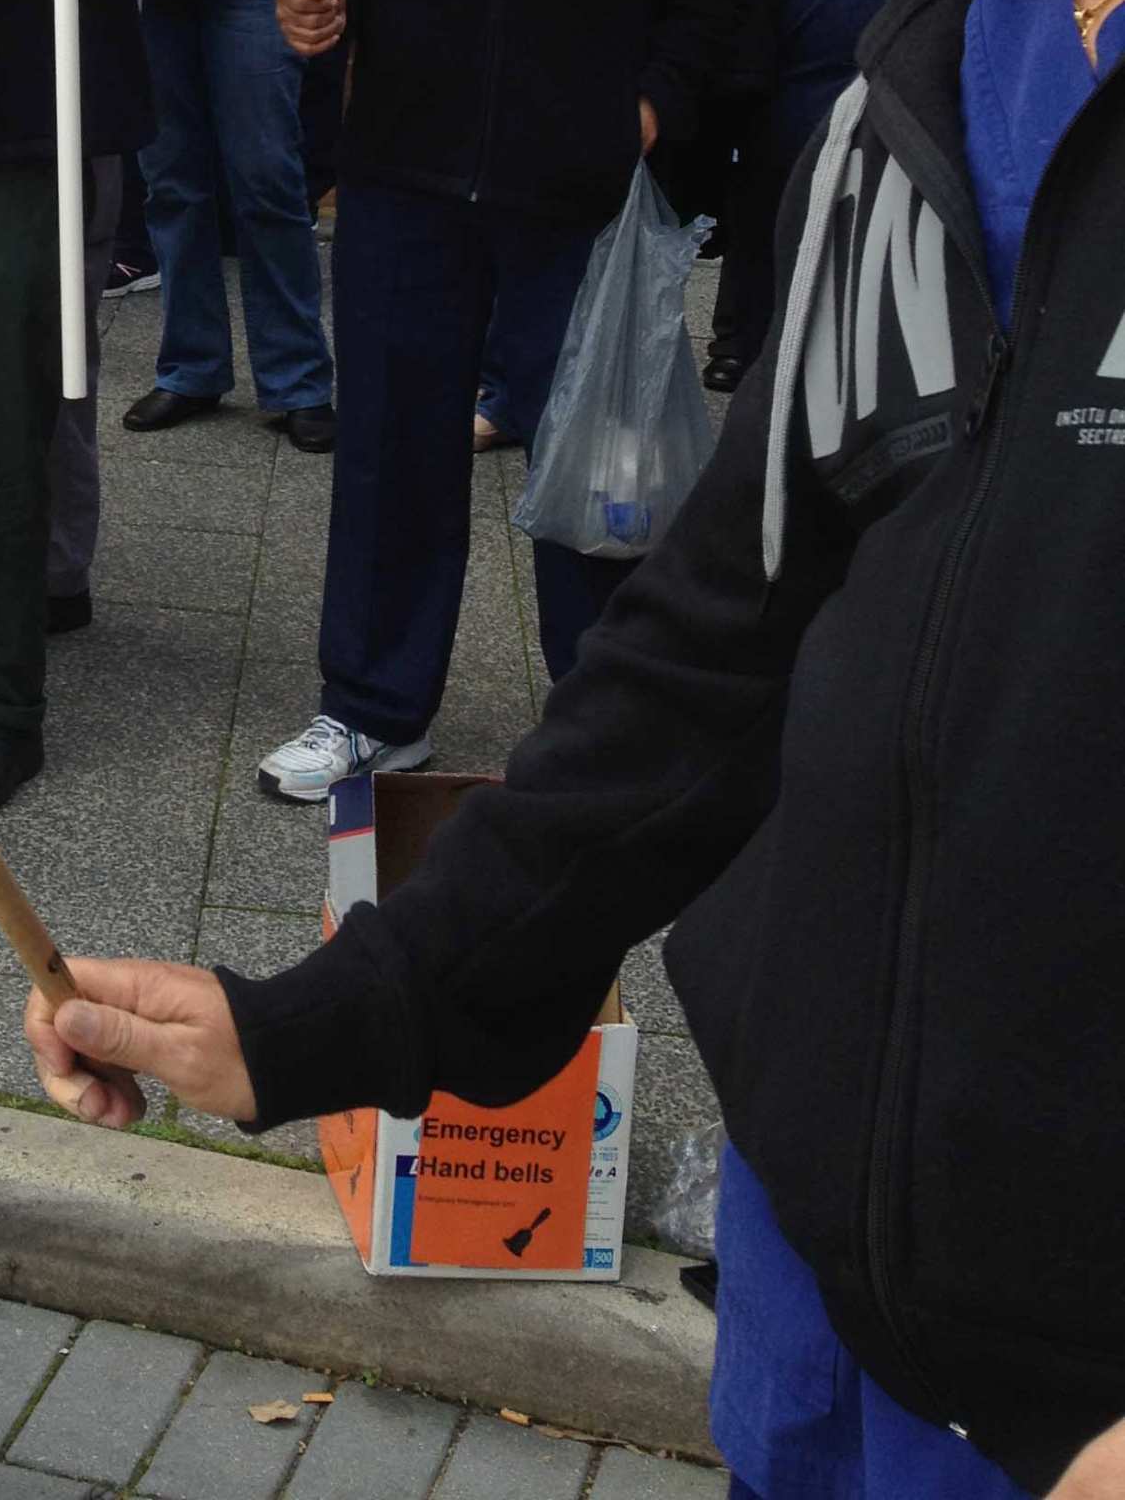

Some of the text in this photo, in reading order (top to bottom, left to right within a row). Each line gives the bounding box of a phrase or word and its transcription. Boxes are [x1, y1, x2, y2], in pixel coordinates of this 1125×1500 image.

[422, 1117, 567, 1151] Emergency
[420, 1156, 486, 1181] Hand
[494, 1160, 555, 1184] bells
[594, 1251, 613, 1264] 500
